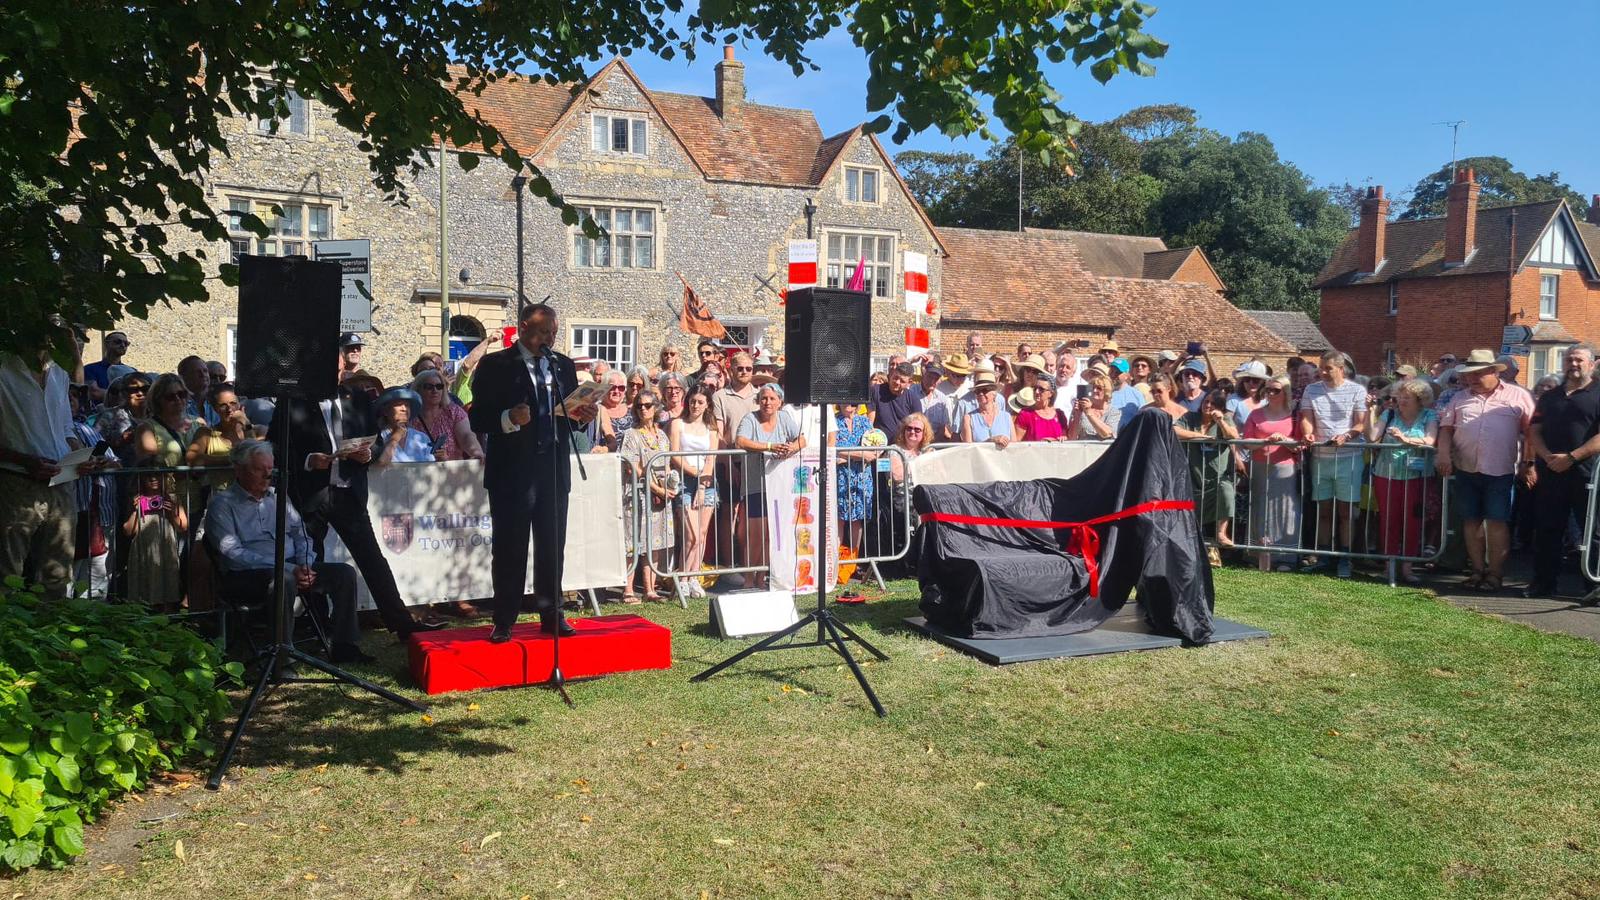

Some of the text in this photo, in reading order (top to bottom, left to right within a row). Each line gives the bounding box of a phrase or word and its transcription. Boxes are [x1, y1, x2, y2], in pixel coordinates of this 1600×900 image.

[418, 513, 491, 530] Walling
[418, 533, 492, 550] Town Co
